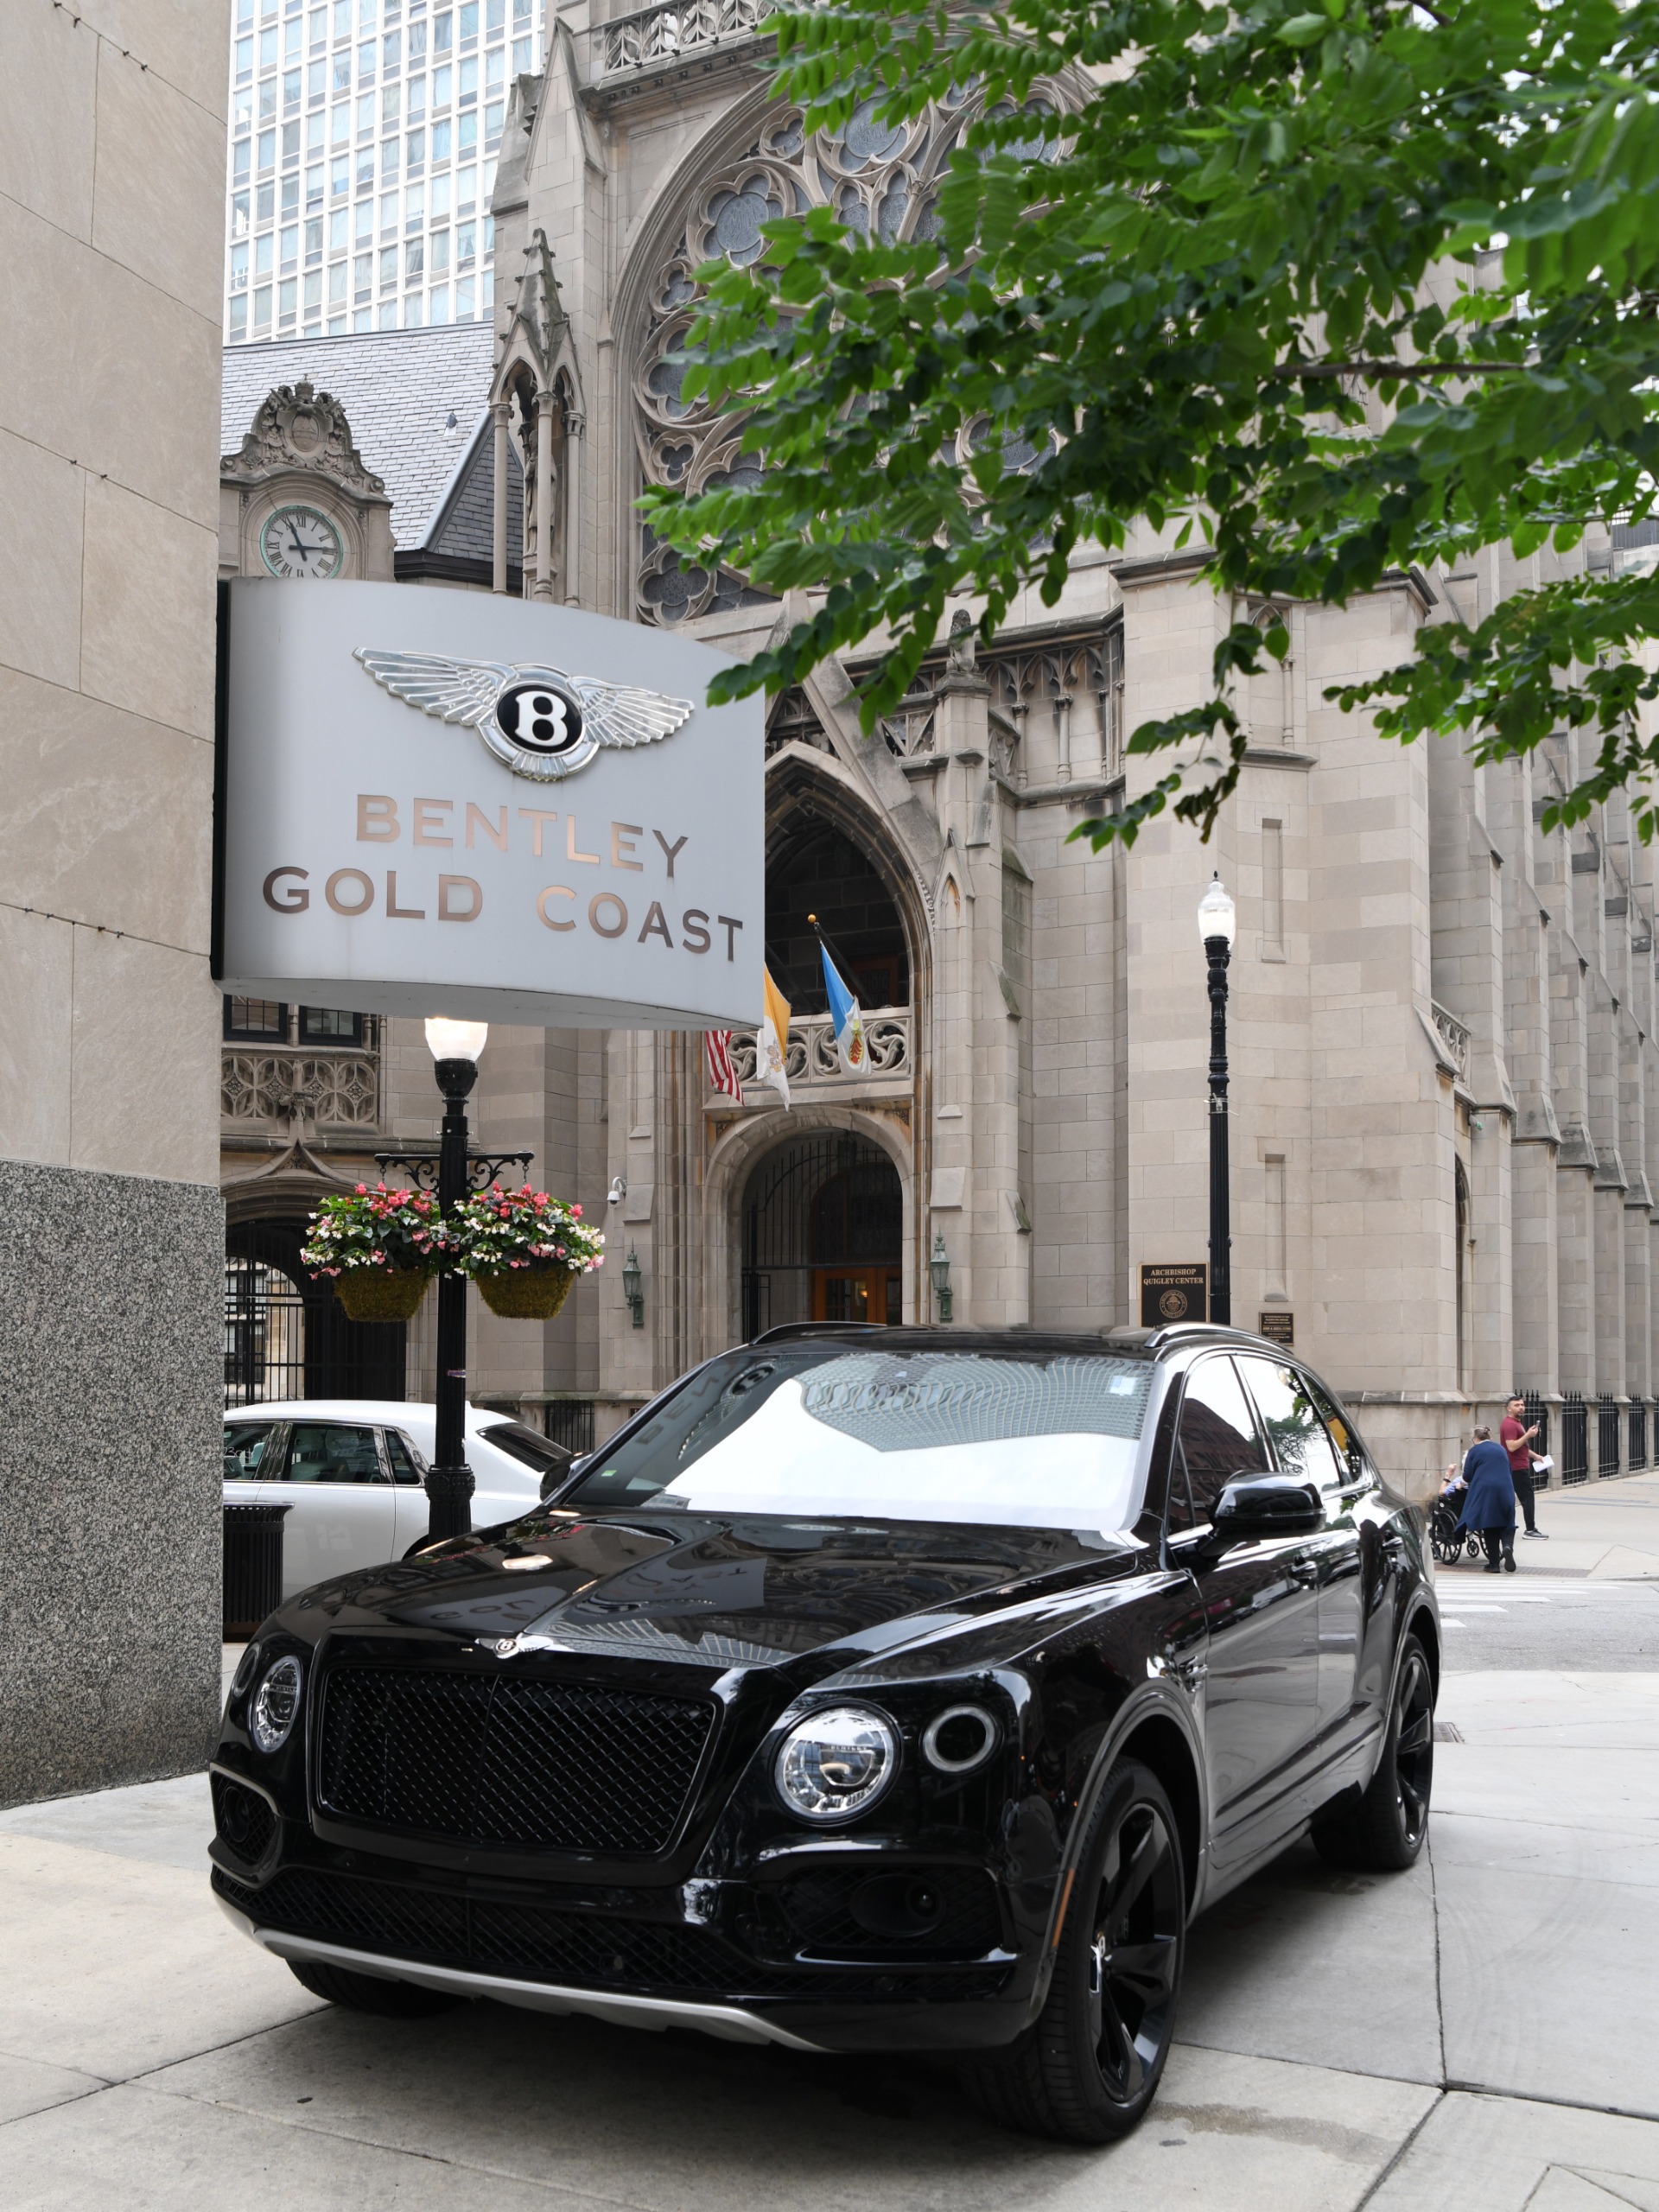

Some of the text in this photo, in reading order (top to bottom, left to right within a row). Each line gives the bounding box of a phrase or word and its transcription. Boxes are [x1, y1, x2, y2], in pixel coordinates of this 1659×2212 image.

[515, 690, 568, 747] B
[356, 794, 689, 879] BENTLEY
[262, 866, 744, 963] GOLD COAST
